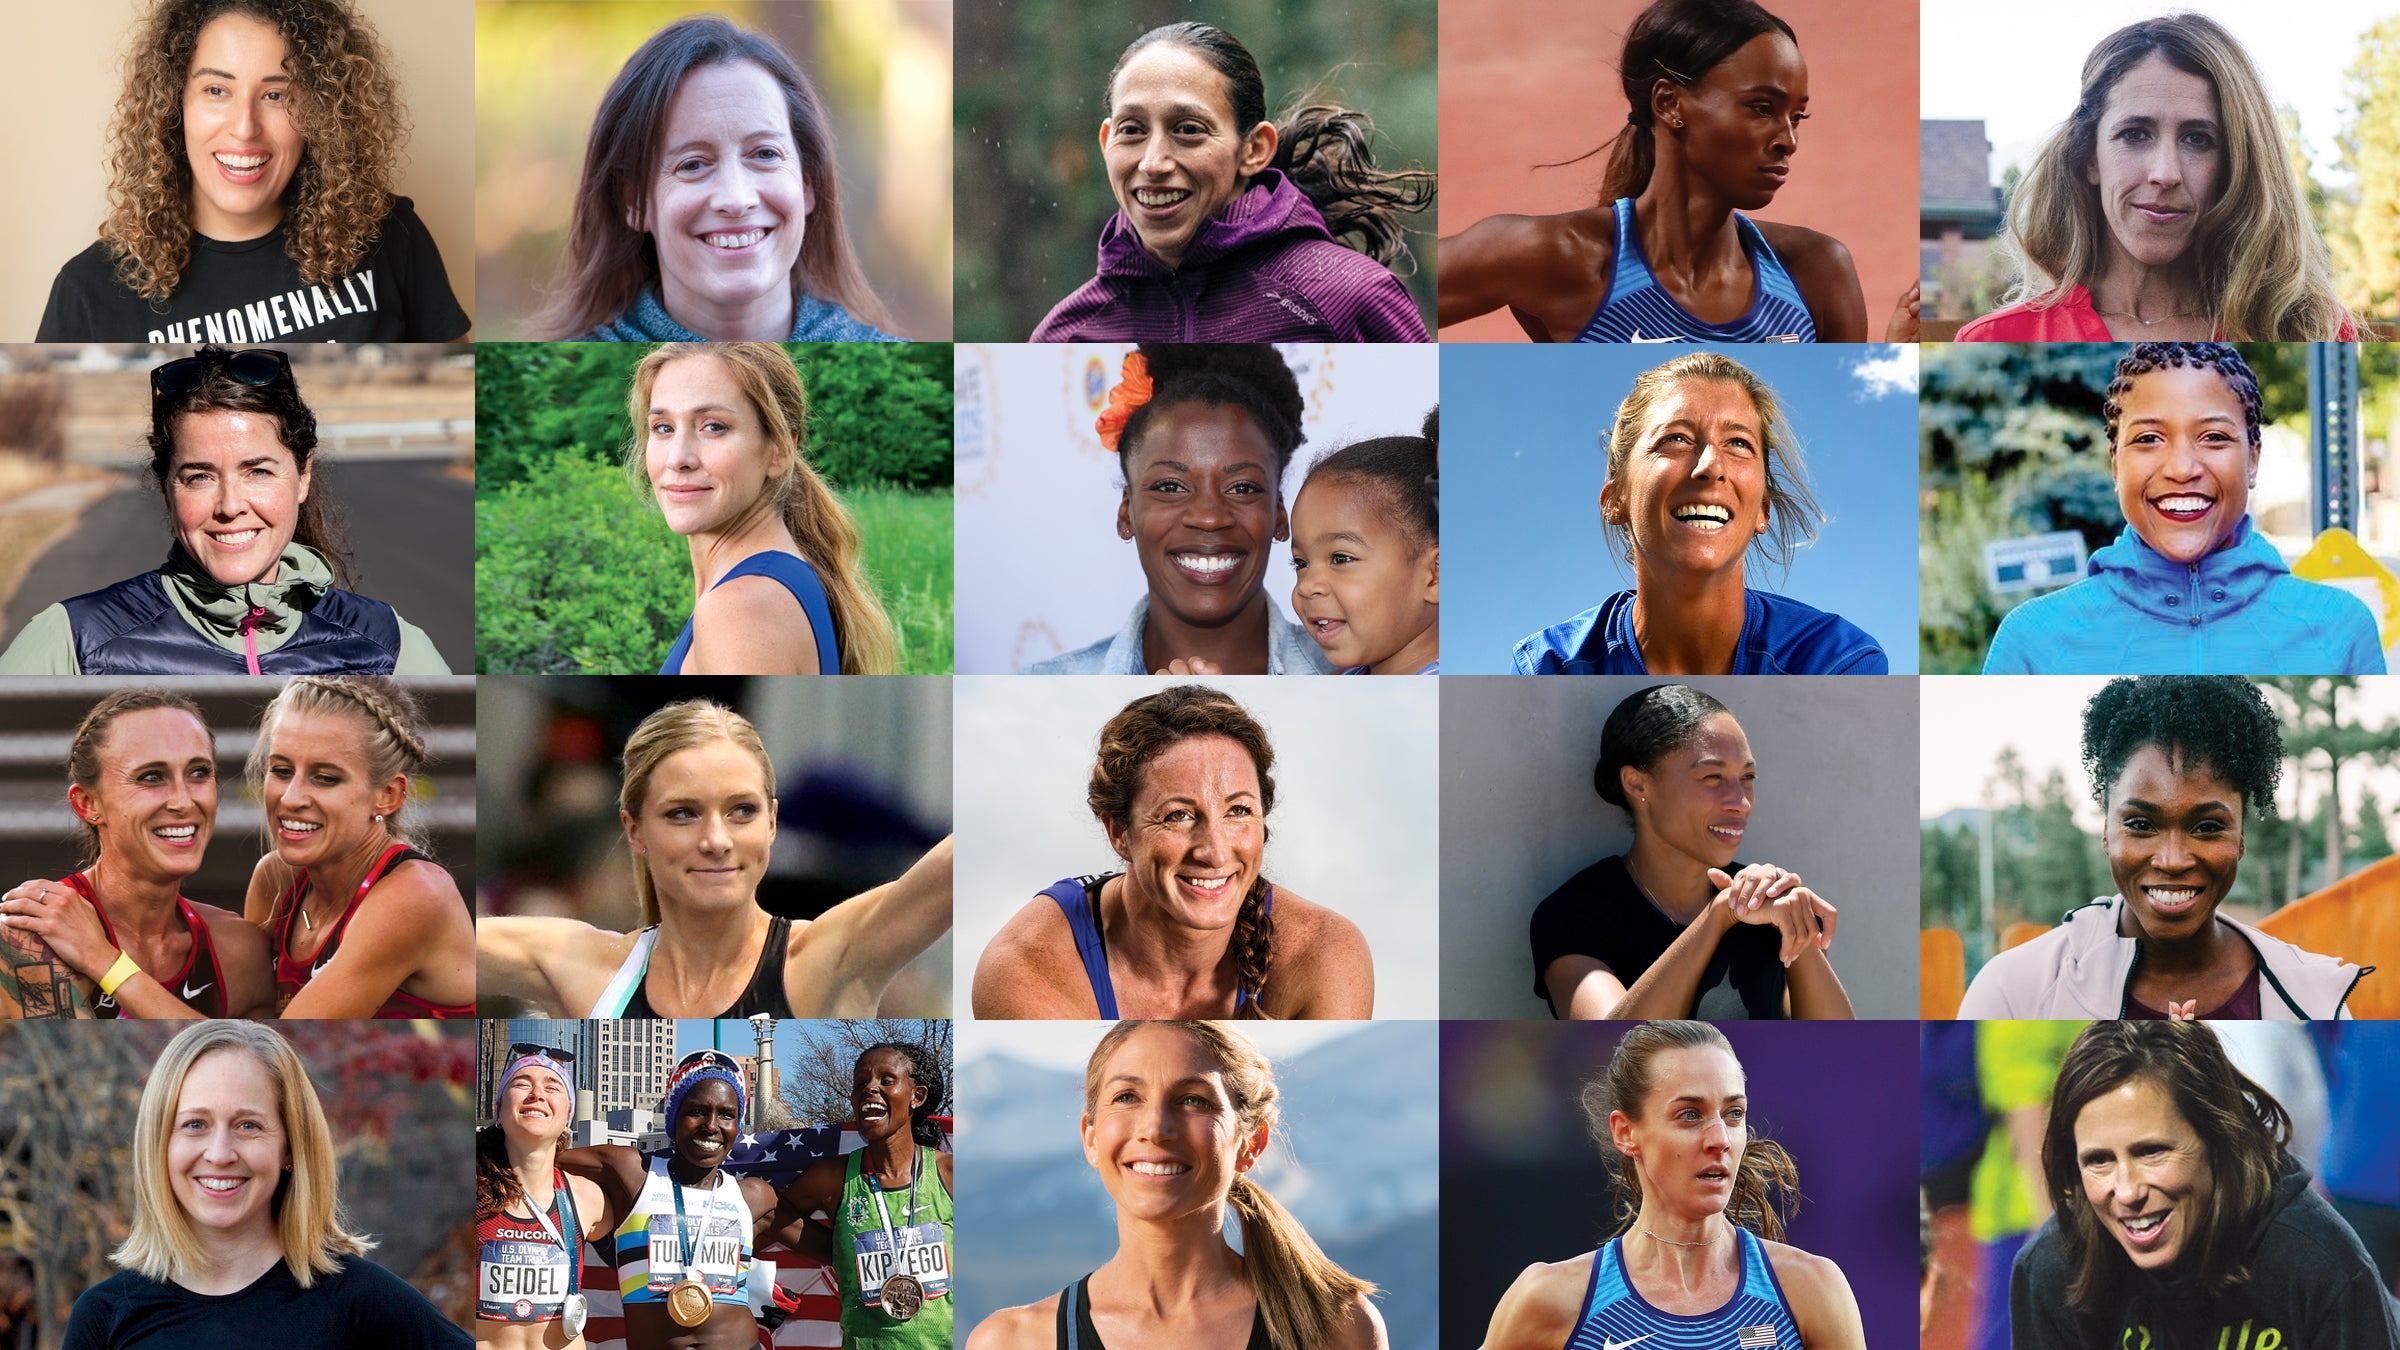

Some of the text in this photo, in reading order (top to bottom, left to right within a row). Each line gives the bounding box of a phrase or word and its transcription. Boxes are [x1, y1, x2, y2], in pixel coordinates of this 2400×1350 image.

[1280, 298, 1318, 325] BROOKS
[496, 1228, 554, 1242] saucon
[502, 1254, 522, 1264] TEAM
[652, 1240, 737, 1265] TULMUK
[489, 1265, 559, 1296] SEIDEL
